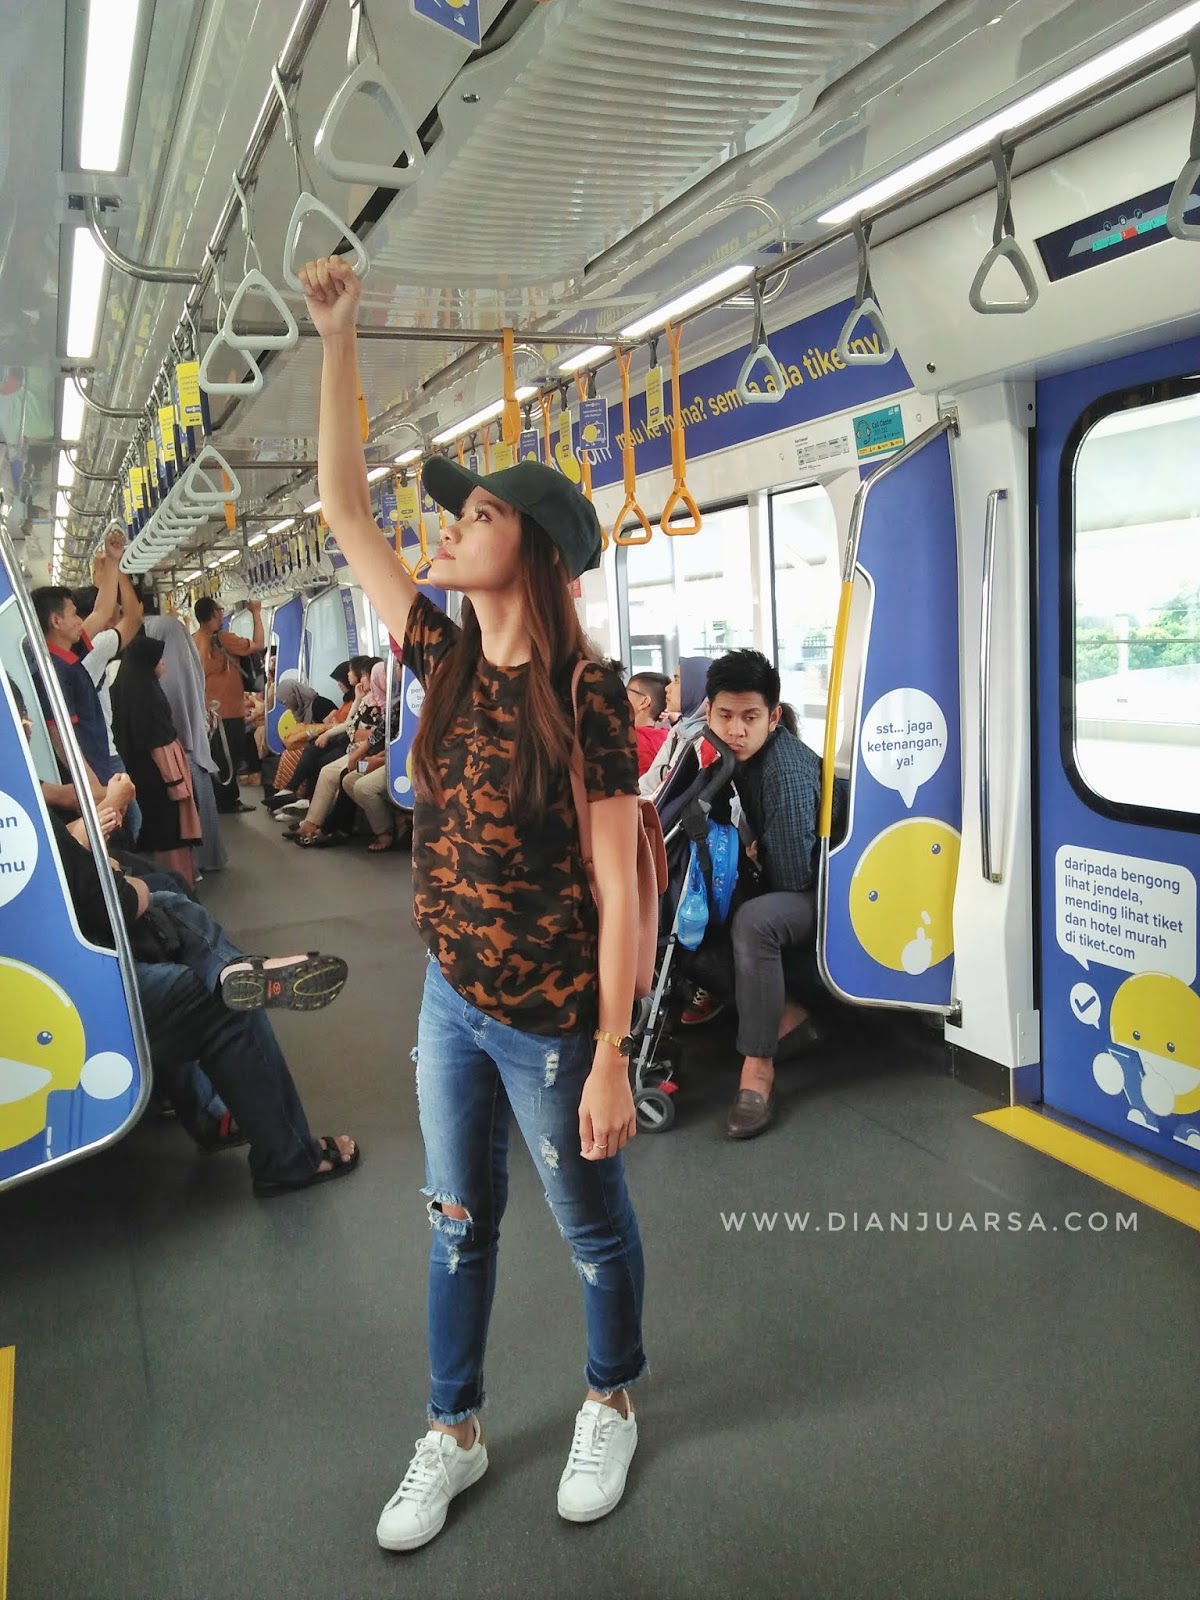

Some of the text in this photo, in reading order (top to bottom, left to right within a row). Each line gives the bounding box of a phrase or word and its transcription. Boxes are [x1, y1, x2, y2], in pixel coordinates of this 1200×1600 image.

[876, 720, 933, 735] sst... jaga
[867, 737, 942, 753] ketenangan,
[896, 754, 914, 770] ya!
[1064, 857, 1181, 895] daripada bengong
[1064, 874, 1143, 906] lihat jendela,
[1065, 895, 1184, 933] mending lihat tiket
[1065, 912, 1167, 949] dan hotel murah
[1065, 930, 1136, 960] di tiket.com
